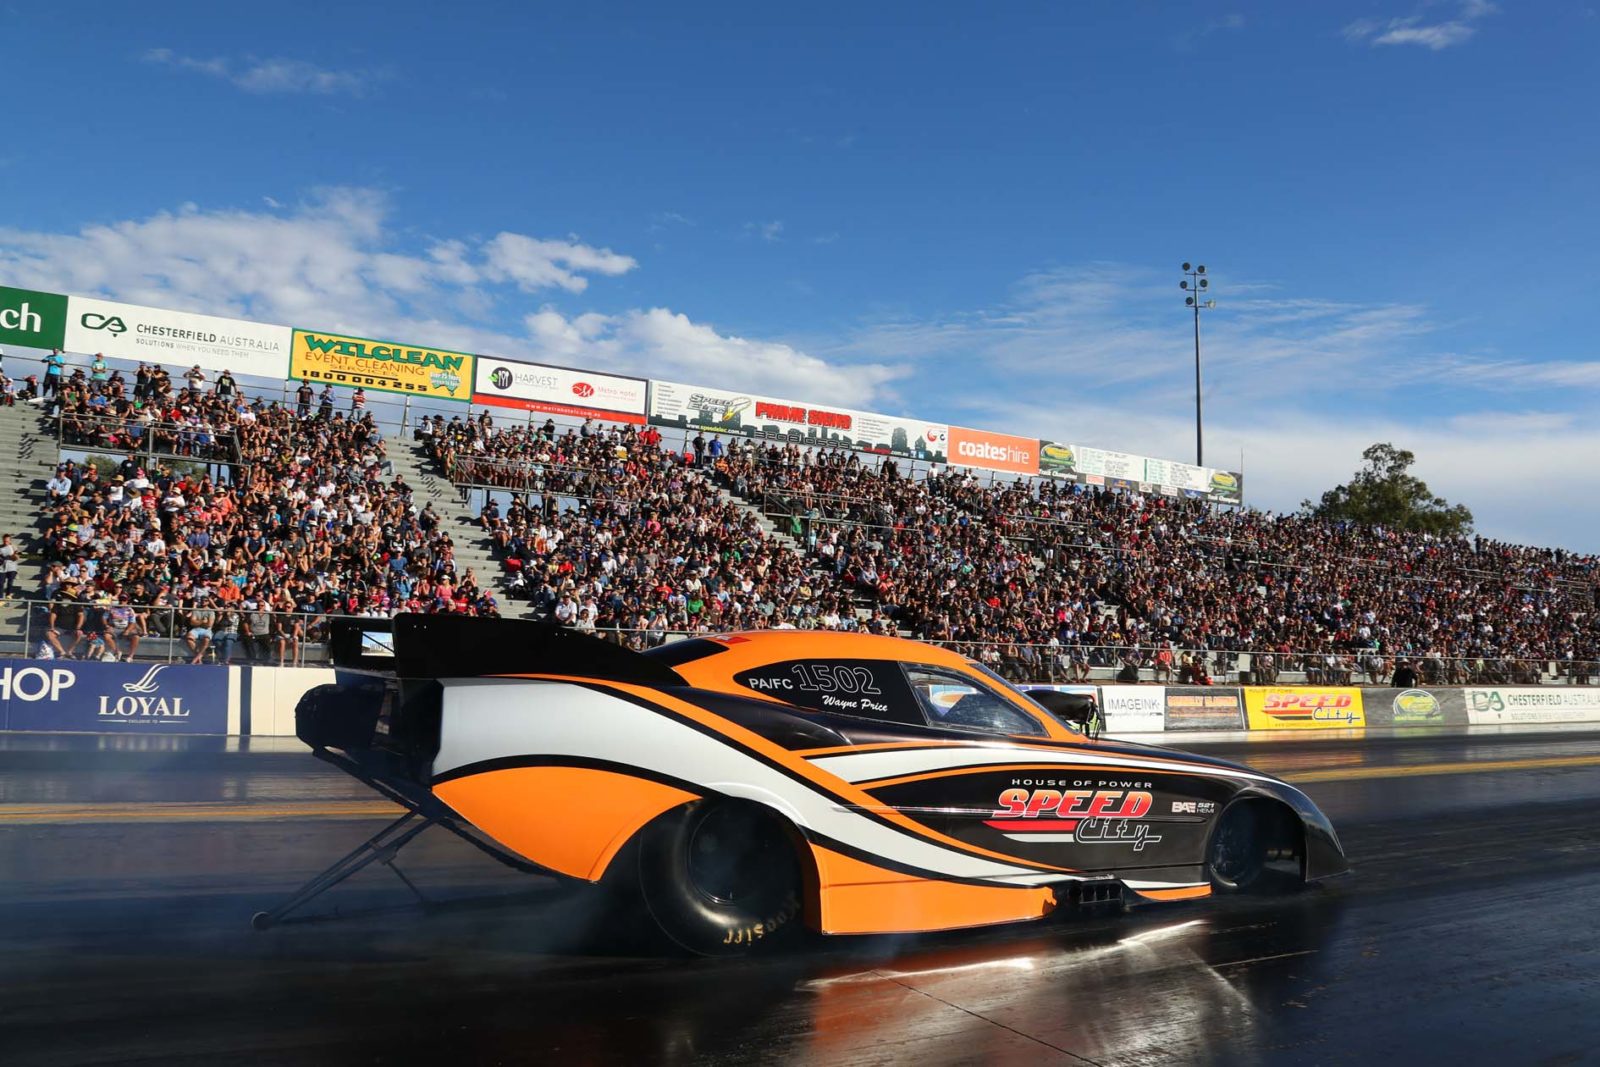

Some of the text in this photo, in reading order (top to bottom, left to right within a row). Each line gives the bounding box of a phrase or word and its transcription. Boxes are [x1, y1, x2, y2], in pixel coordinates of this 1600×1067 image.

[0, 302, 42, 333] ch
[136, 323, 280, 351] CHESTERFIELD AUSTRALIA
[136, 338, 249, 358] SOLUTIONS WHEN YOU NEED THEM
[304, 334, 464, 371] WILCLEAN
[305, 351, 425, 376] EVENT CLEANING
[329, 363, 399, 377] SERVICES
[302, 370, 428, 392] 1800 004 255
[515, 373, 559, 386] HARVEST
[748, 664, 882, 695] PA/FC 1502
[98, 695, 191, 717] LOYAL
[822, 695, 888, 712] Wayne Price
[1108, 698, 1158, 710] IMAGEINK
[1263, 693, 1353, 709] SPEED
[1507, 694, 1562, 706] CHESTERFIELD
[1312, 706, 1361, 724] City
[1011, 778, 1067, 787] HOUSE
[1098, 780, 1153, 789] POWER
[992, 788, 1153, 819] SPEED
[1171, 801, 1196, 814] BAE
[1076, 816, 1162, 852] City
